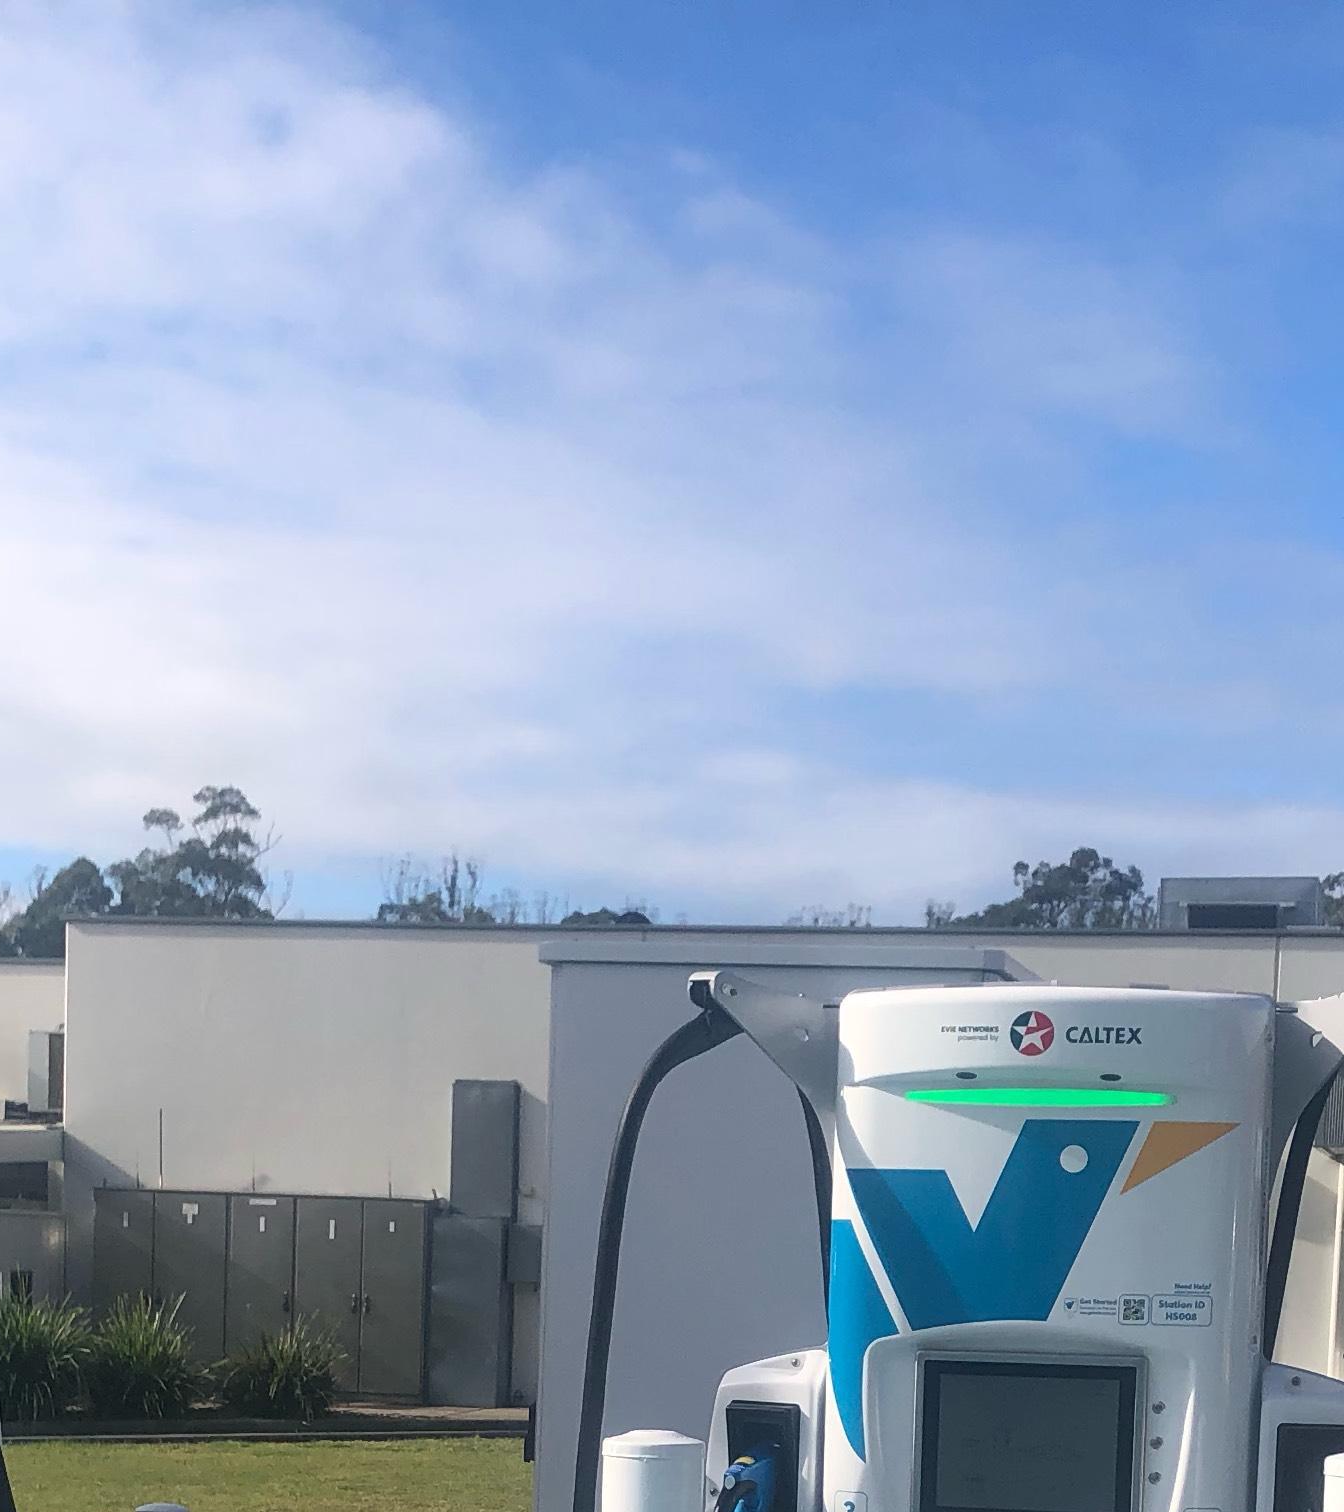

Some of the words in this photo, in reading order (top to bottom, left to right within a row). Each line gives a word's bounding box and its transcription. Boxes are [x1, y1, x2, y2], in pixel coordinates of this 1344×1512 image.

[1065, 1026, 1142, 1045] CALTEX
[1158, 1300, 1193, 1309] Station
[1194, 1301, 1205, 1309] ID
